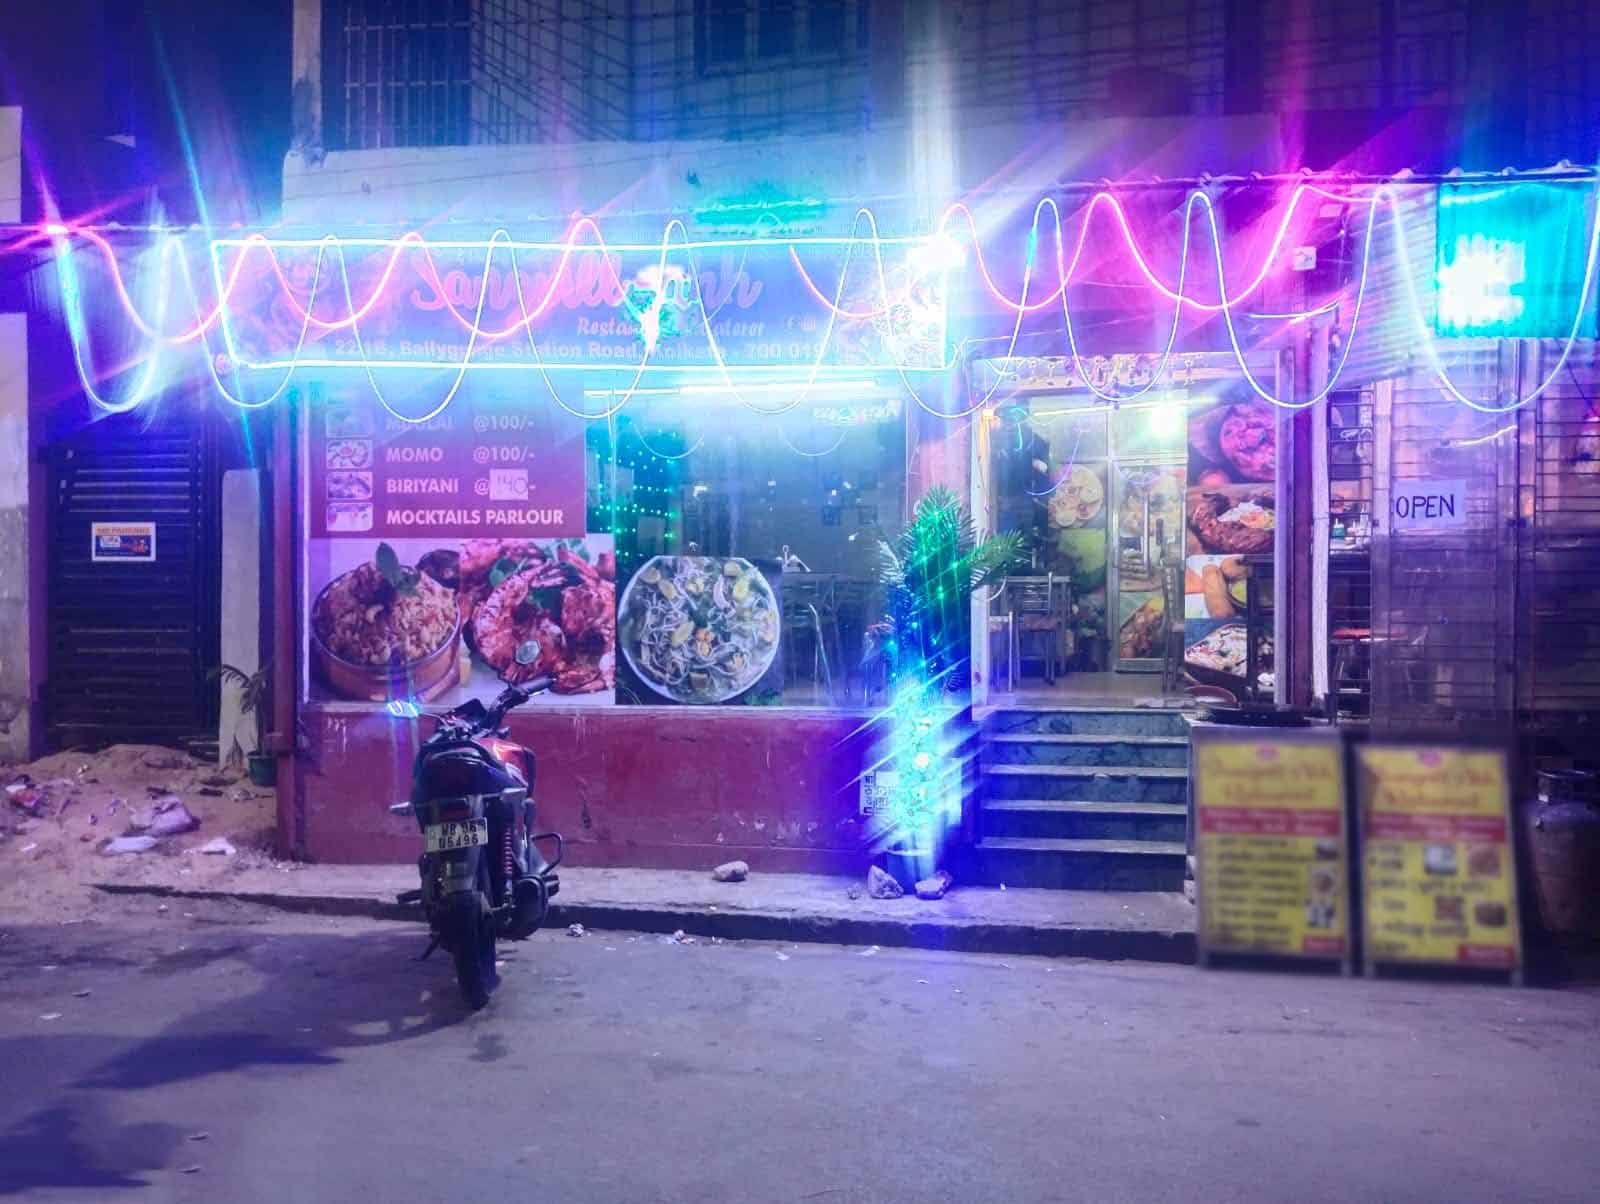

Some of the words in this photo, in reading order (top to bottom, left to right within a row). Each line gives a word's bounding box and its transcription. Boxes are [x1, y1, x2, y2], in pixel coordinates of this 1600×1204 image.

[651, 342, 727, 361] olkaa
[386, 447, 443, 463] MOMO
[473, 445, 536, 464] @100/-
[386, 479, 459, 494] BIRIYANI
[1395, 494, 1455, 518] OPEN
[386, 509, 480, 525] MOCKTAILS
[487, 509, 563, 525] PARLOUR
